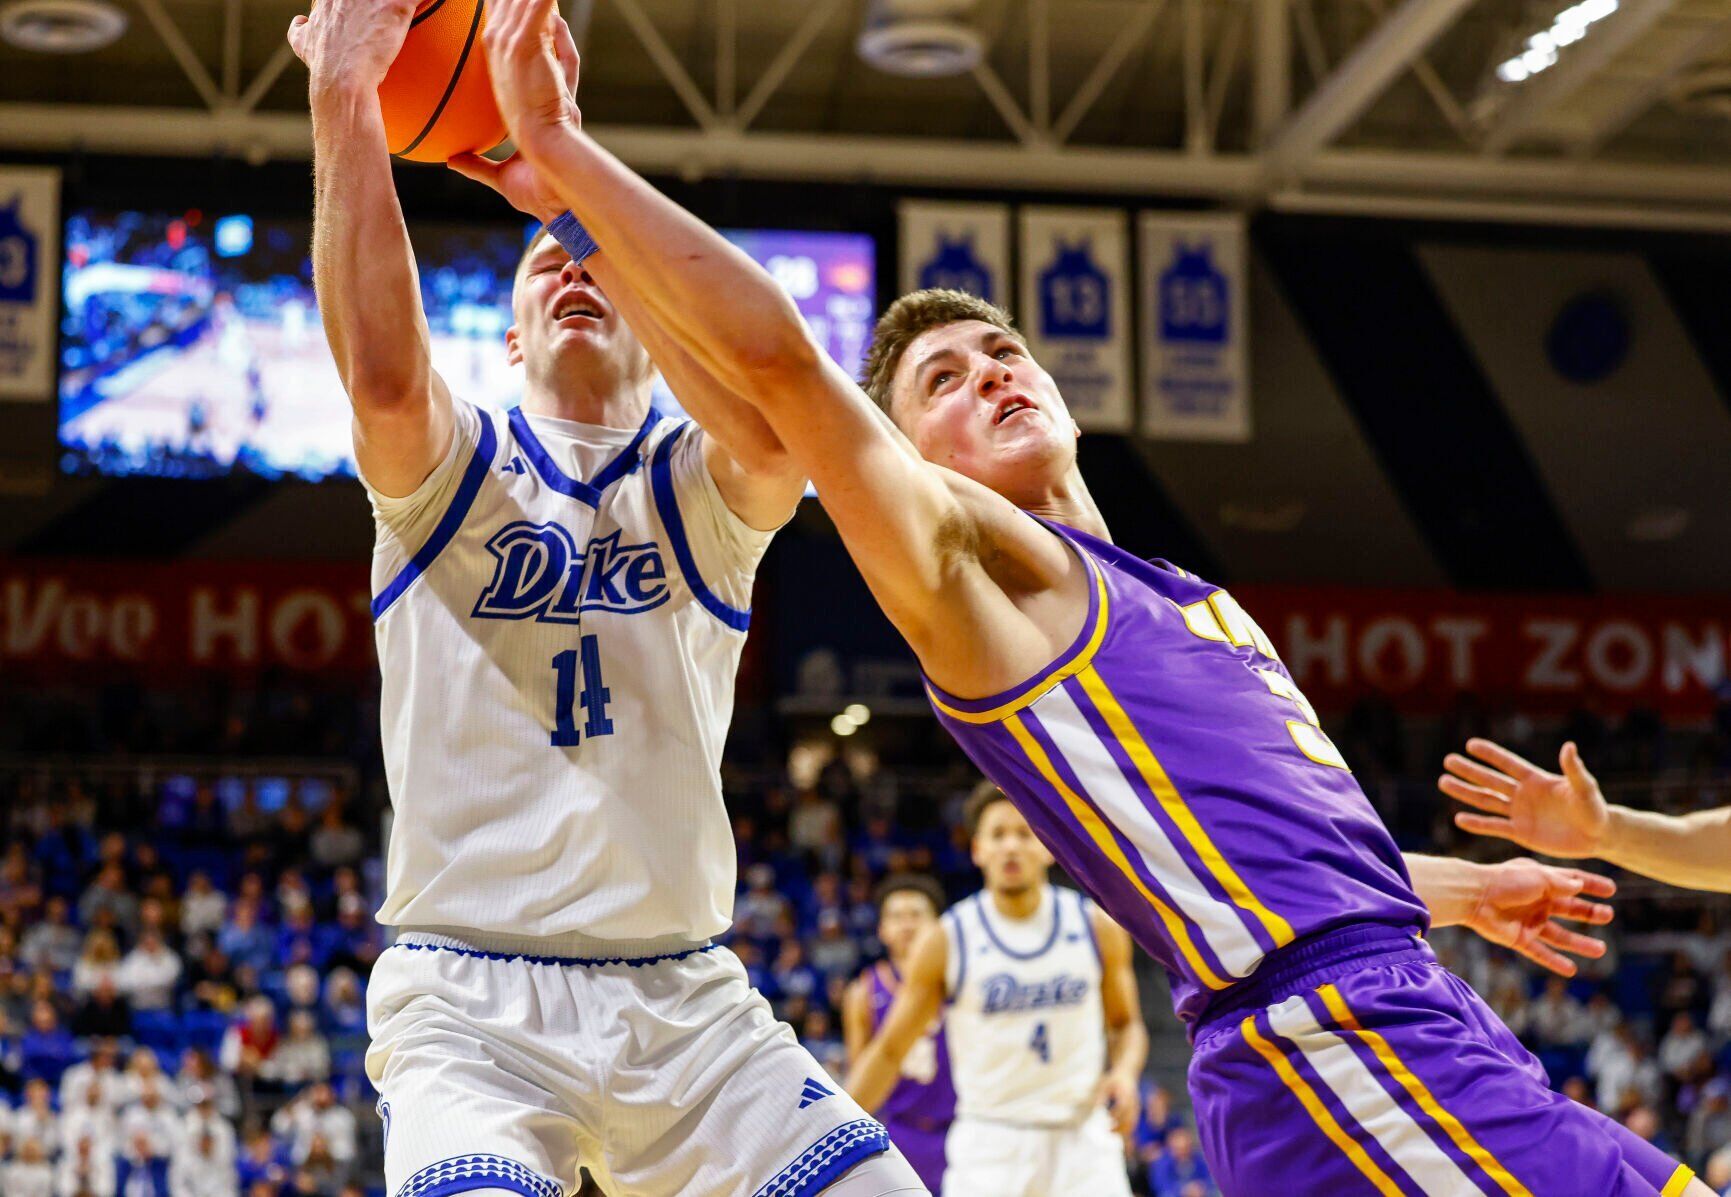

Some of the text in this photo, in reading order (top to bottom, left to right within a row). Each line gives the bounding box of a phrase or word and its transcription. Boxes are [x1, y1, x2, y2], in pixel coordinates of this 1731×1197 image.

[470, 520, 671, 625] Dke
[191, 587, 372, 668] HO
[1286, 614, 1488, 690] HOT
[1029, 1022, 1050, 1064] 4
